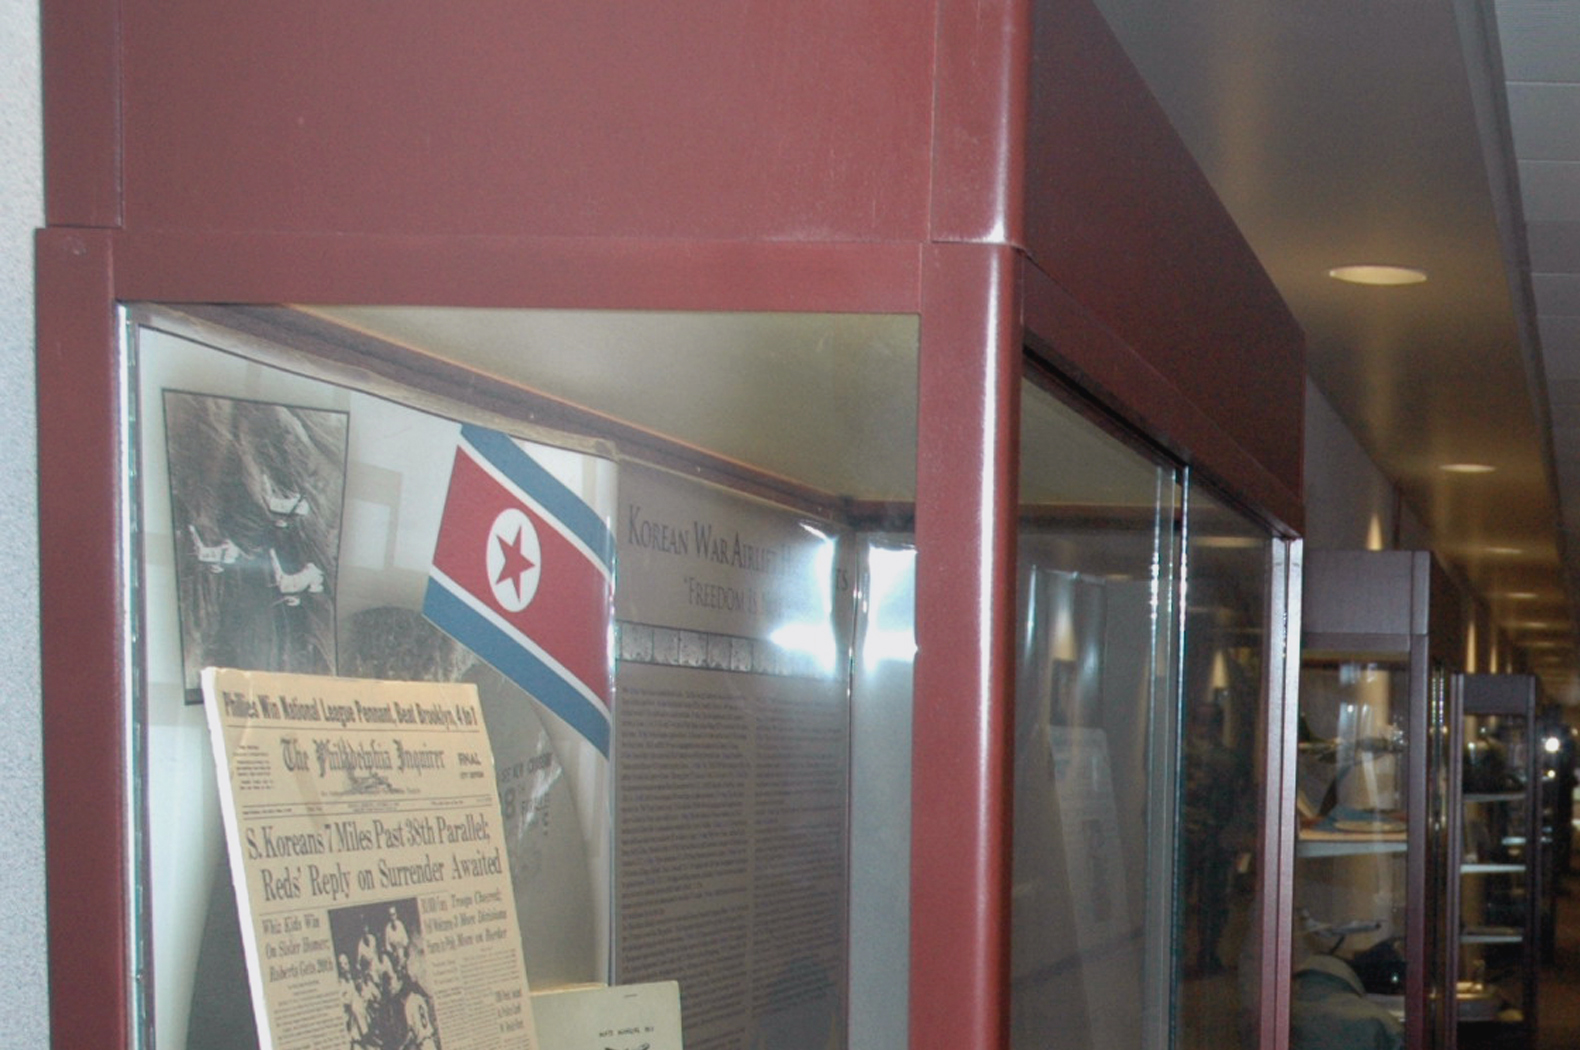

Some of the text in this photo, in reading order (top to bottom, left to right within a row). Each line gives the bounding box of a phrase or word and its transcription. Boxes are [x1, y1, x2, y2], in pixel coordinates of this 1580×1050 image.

[693, 521, 728, 569] WAR
[279, 696, 321, 721] National
[318, 697, 356, 728] League
[393, 701, 417, 724] Beat
[280, 737, 310, 772] The
[313, 736, 393, 778] Philadelphia
[393, 738, 445, 777] Inquirer
[457, 752, 482, 766] FINAL
[245, 827, 262, 860] S.
[261, 825, 324, 858] Koreans
[324, 823, 333, 853] 7
[334, 821, 373, 853] Miles
[373, 819, 405, 849] Past
[405, 815, 436, 847] 38th
[307, 862, 350, 901] Reply
[357, 868, 376, 891] on
[378, 853, 444, 889] Surrender
[452, 847, 503, 880] Awaited
[304, 913, 320, 928] Win
[265, 942, 277, 959] On
